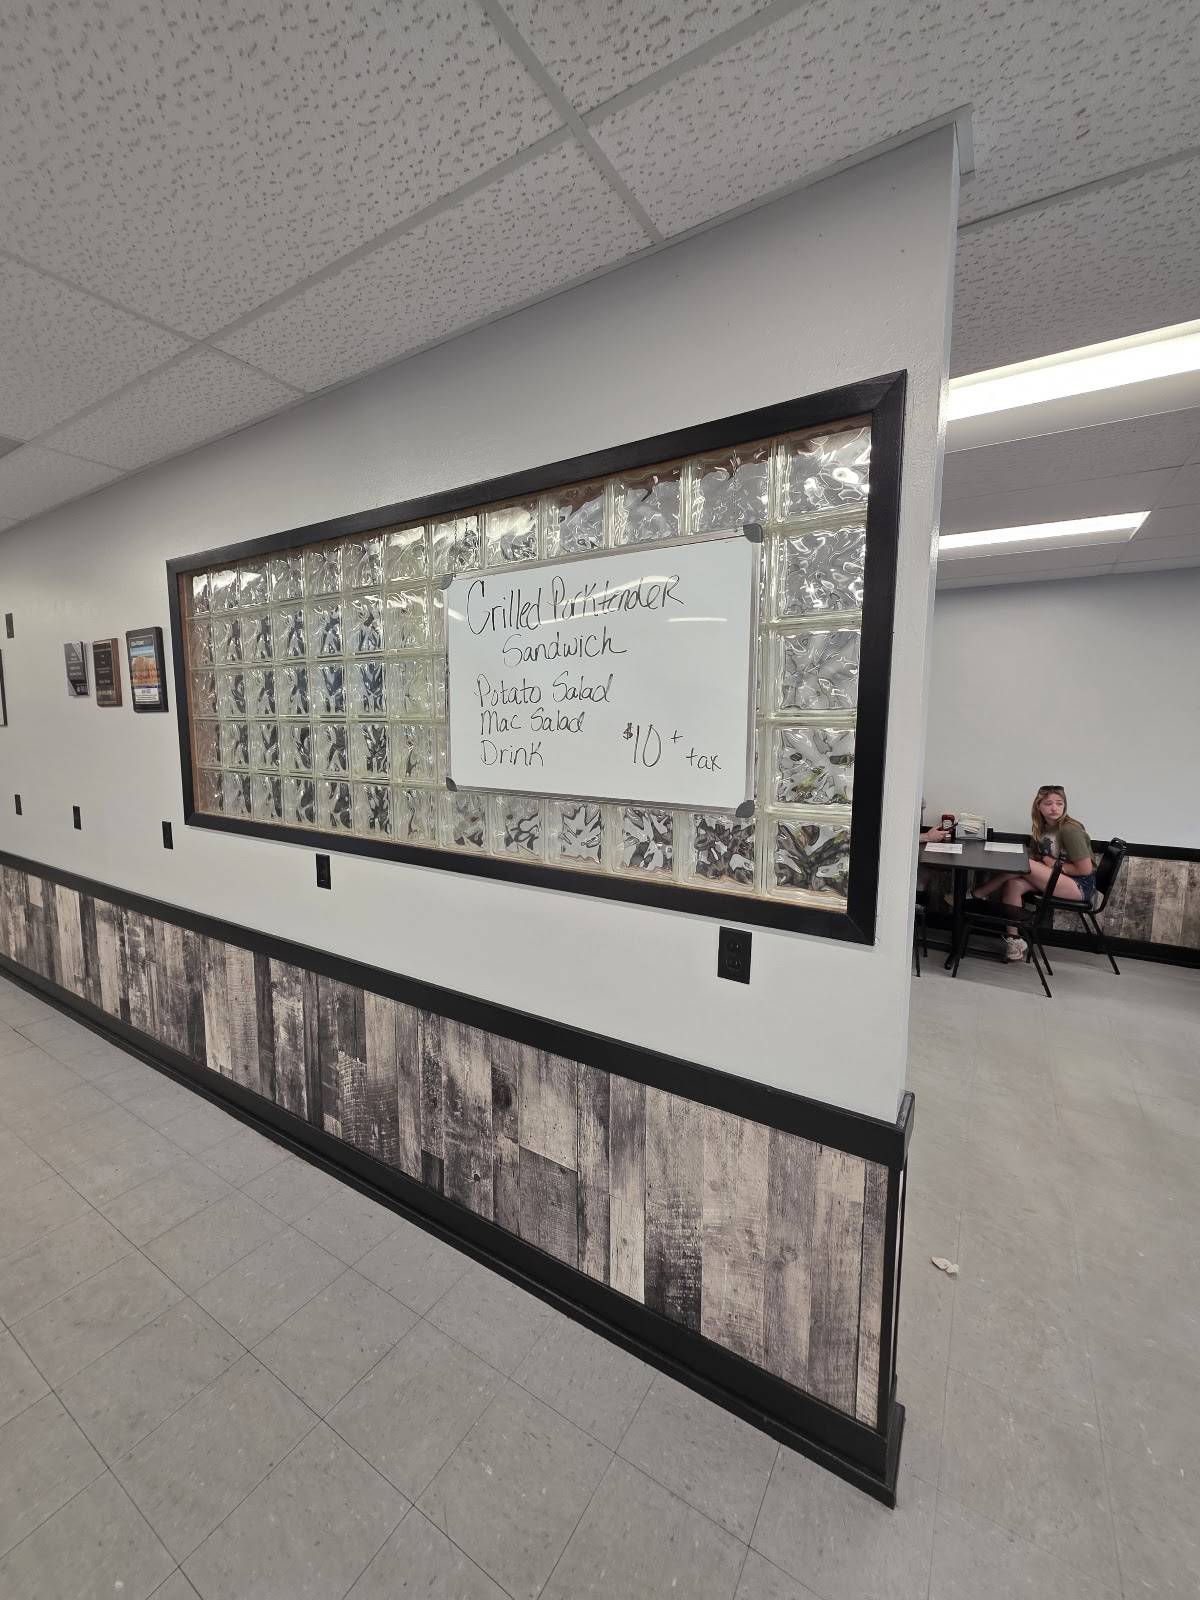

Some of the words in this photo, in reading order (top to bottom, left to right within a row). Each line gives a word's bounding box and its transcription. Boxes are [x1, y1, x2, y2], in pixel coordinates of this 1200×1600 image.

[466, 579, 542, 635] Grilled
[502, 626, 627, 667] Sandwich
[474, 673, 542, 708] Potato
[552, 670, 613, 703] Salad
[481, 709, 521, 735] Mac
[530, 706, 585, 733] Salad
[480, 739, 544, 767] Drink
[622, 722, 662, 768] $10
[686, 746, 722, 771] tax
